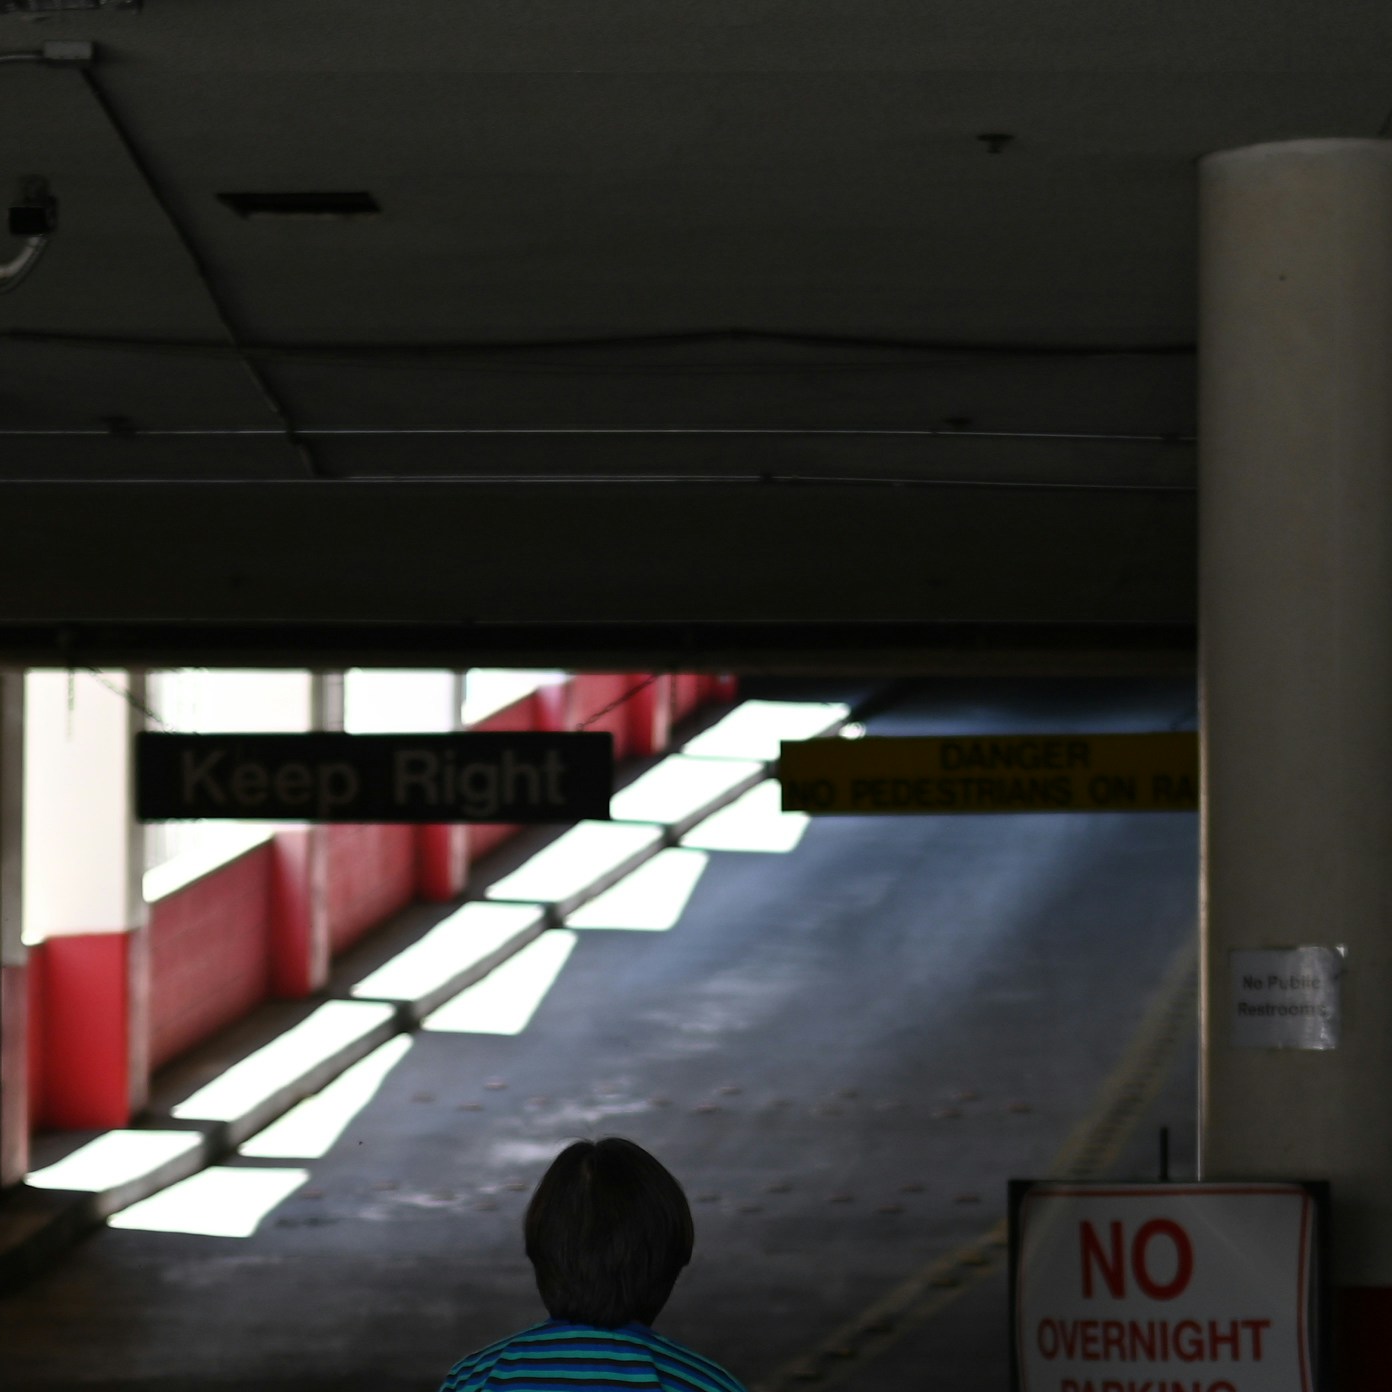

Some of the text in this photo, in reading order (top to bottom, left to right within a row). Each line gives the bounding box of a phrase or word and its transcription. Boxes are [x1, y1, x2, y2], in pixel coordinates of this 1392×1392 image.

[939, 740, 1092, 770] DANGER
[180, 747, 570, 819] Keep Right
[788, 773, 1198, 808] NO PEDESTRIANS ON RA
[1242, 975, 1321, 991] No Public
[1237, 1001, 1328, 1017] Restrooms
[1080, 1220, 1194, 1302] NO
[1038, 1318, 1271, 1364] OVERNIGHT
